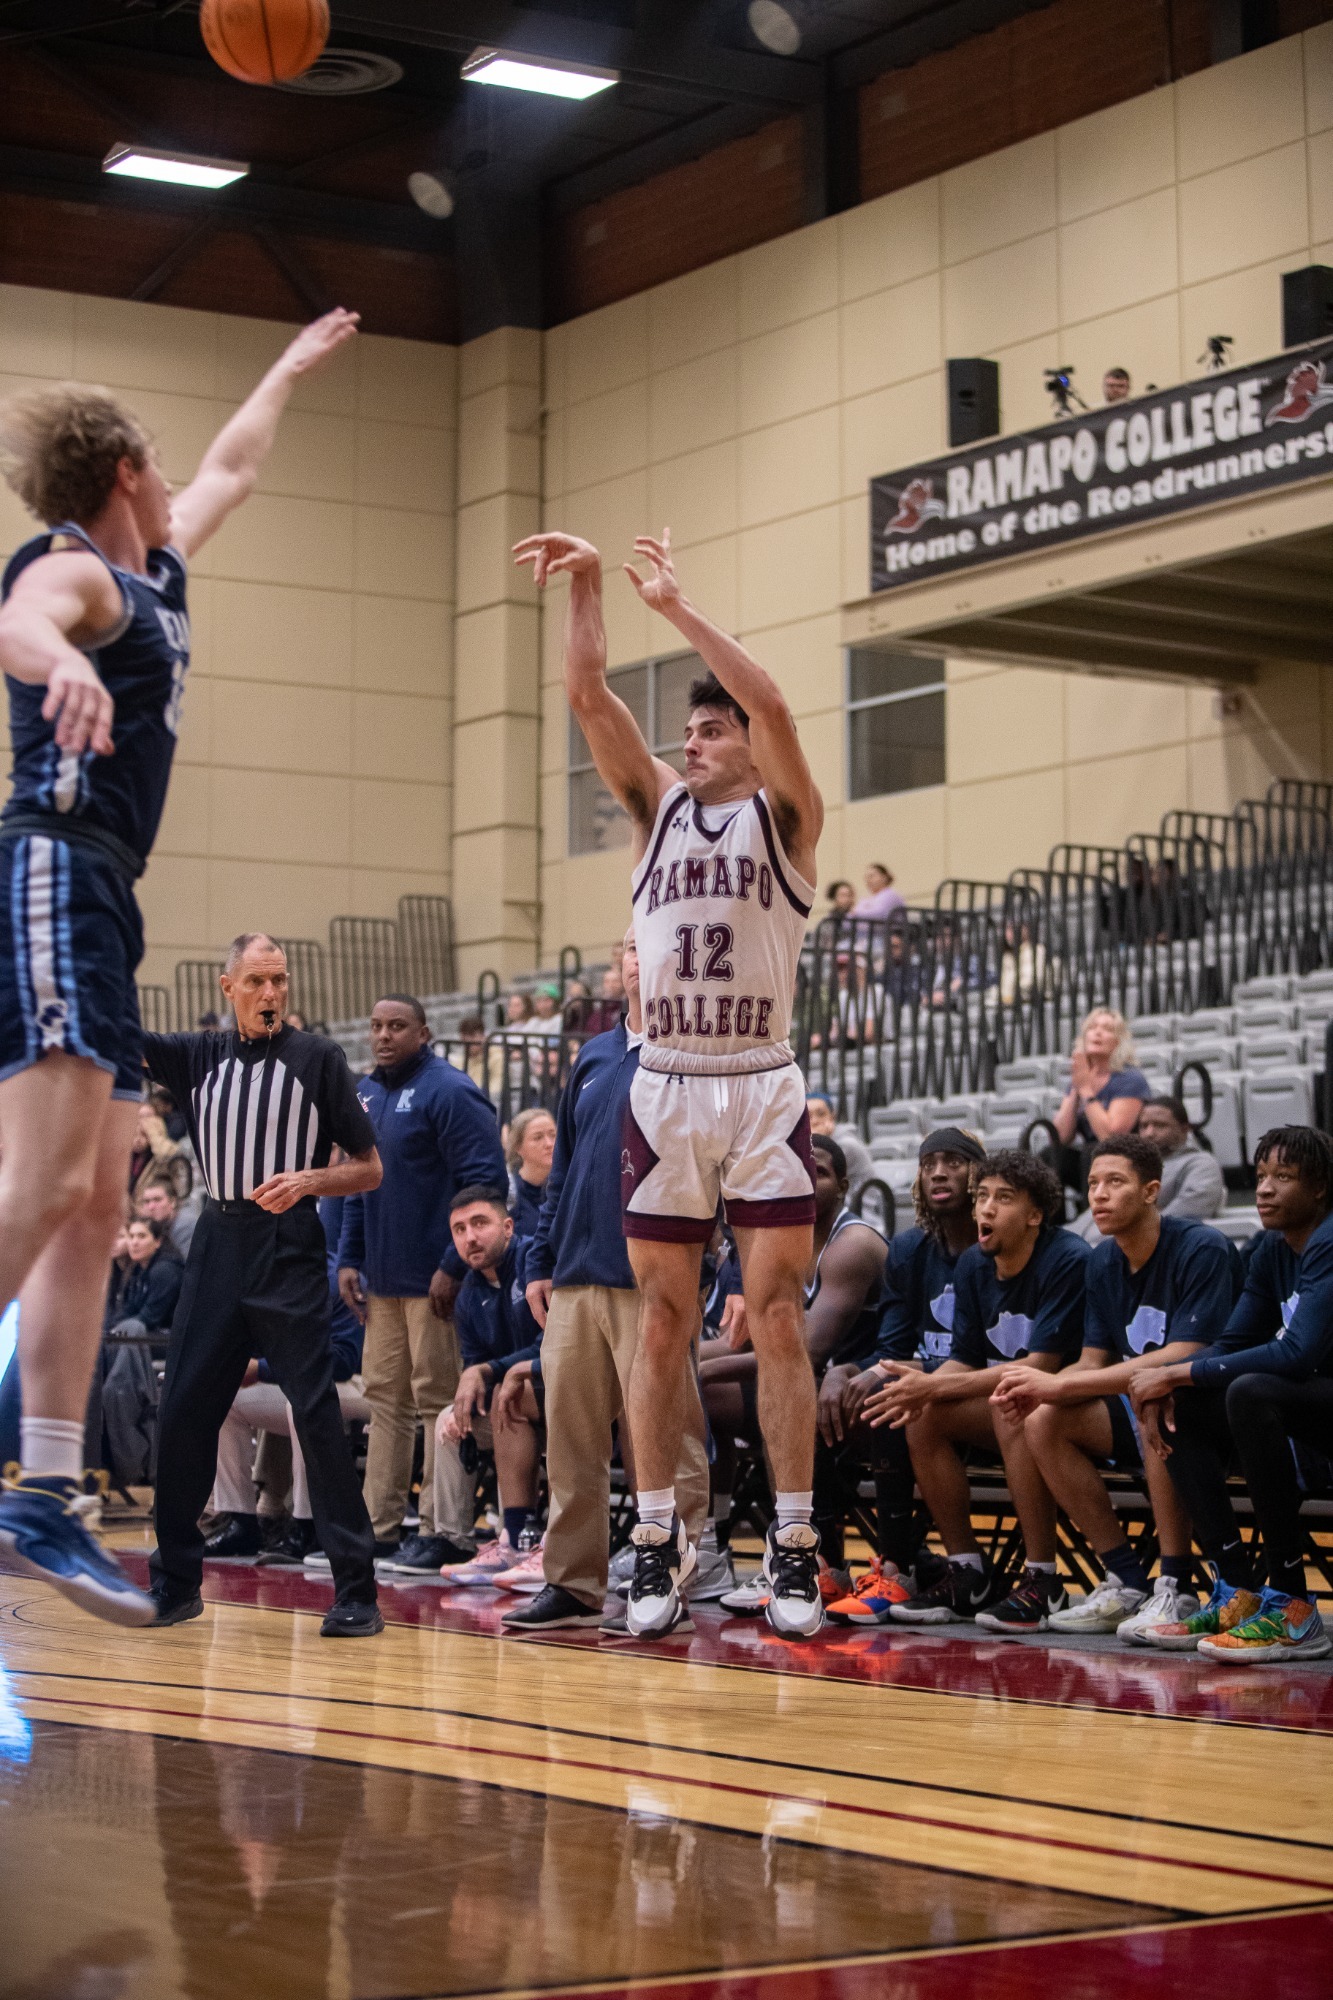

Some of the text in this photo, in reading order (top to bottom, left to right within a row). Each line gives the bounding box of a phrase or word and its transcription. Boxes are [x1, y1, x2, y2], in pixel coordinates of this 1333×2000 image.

[946, 379, 1263, 519] RAMAPO COLLEGE
[885, 527, 976, 572] Home
[982, 513, 1017, 546] of
[1024, 500, 1081, 534] the
[646, 855, 773, 916] RAMAPO
[673, 922, 735, 981] 12
[646, 994, 774, 1041] COLLEGE
